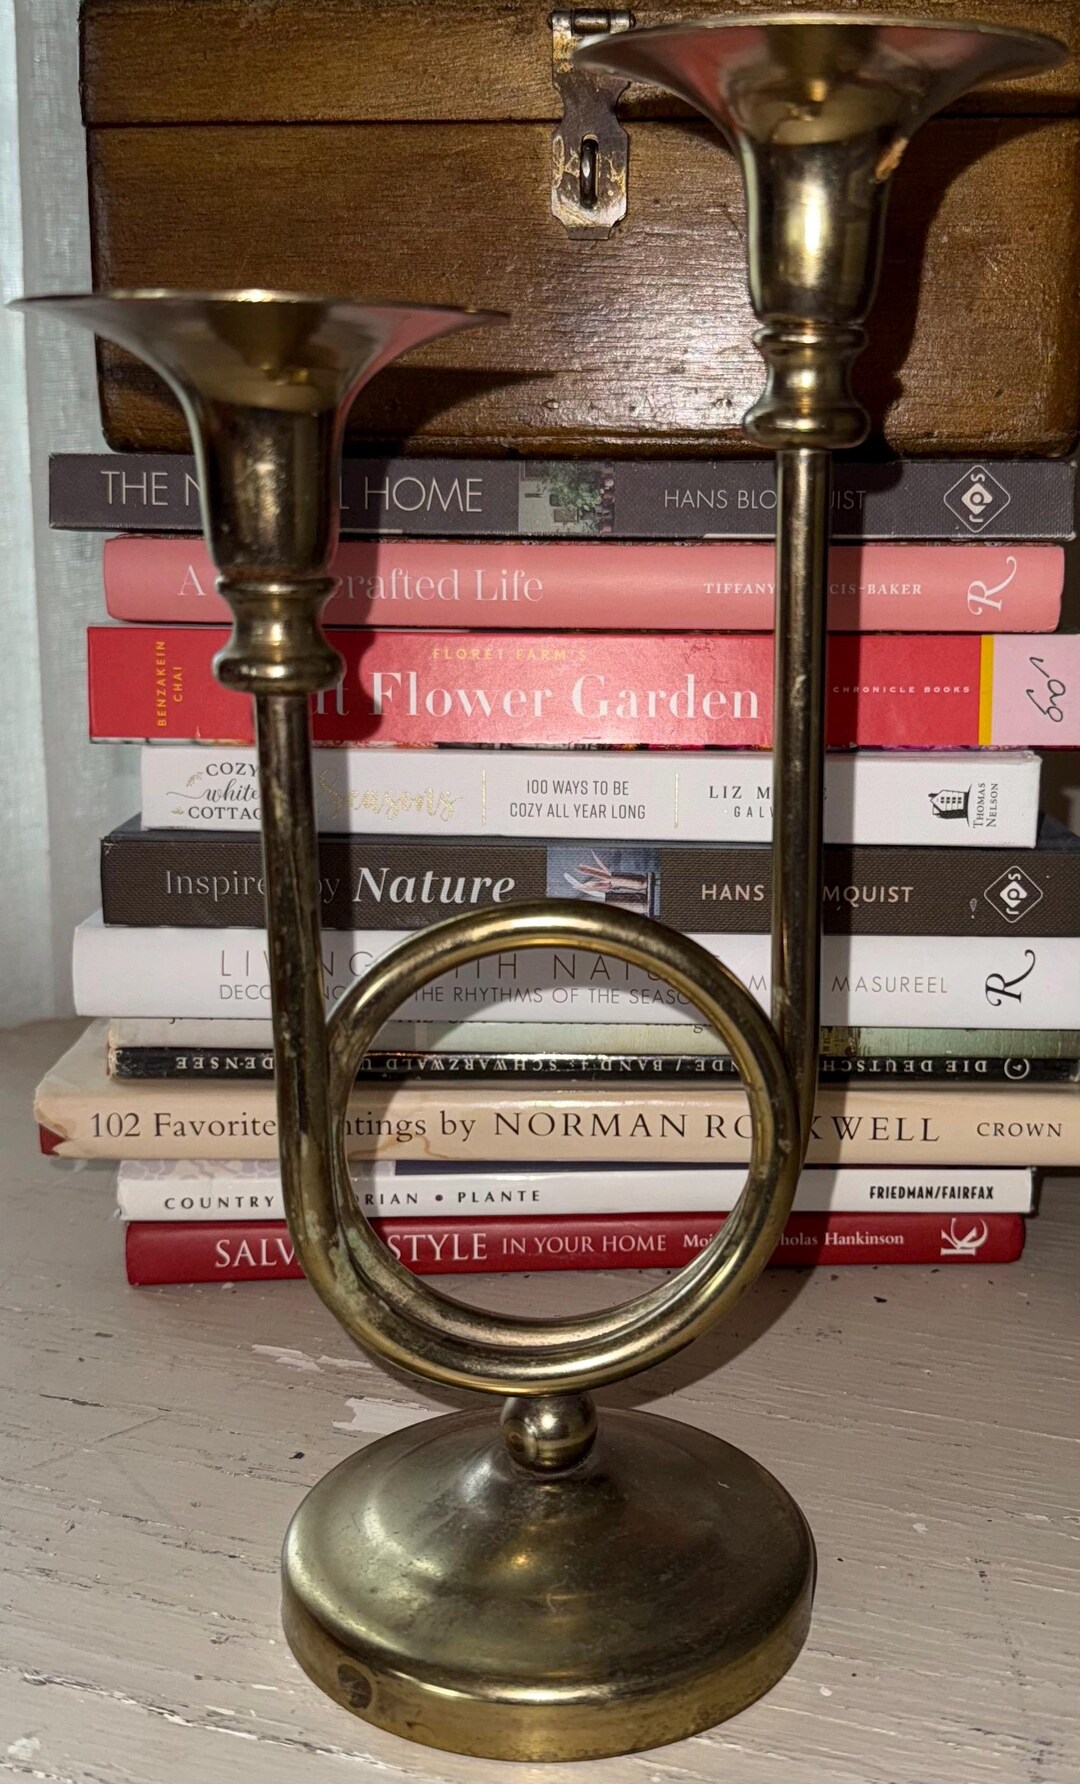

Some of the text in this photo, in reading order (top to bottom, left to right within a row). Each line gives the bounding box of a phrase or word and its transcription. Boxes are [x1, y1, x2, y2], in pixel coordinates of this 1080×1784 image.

[100, 470, 168, 506] THE
[364, 476, 483, 512] HOME
[664, 489, 728, 509] HANS
[177, 563, 206, 597] A
[472, 568, 544, 602] Life
[703, 583, 775, 595] TIFFANY
[967, 556, 1017, 615] R
[156, 641, 167, 727] BENZAKEIN
[173, 666, 183, 703] CHAI
[832, 686, 970, 694] CHRONICLE BOOKS
[368, 670, 553, 718] Flower
[571, 672, 762, 720] Garden
[205, 762, 259, 777] COZY
[526, 779, 630, 796] 100 WAYS TO BE
[709, 785, 743, 799] LIZ
[509, 802, 646, 820] COZY ALL YEAR LONG
[972, 782, 986, 829] THOMAS
[985, 782, 999, 828] NELSON
[352, 867, 516, 904] Nature
[701, 884, 765, 901] HANS
[831, 975, 948, 994] MASUREEL
[985, 949, 1036, 1007] R
[453, 986, 543, 1004] RHYTHMS
[552, 987, 579, 1004] OF
[588, 988, 620, 1004] THE
[385, 1057, 559, 1072] SCHWARZWALD
[601, 1058, 663, 1072] BAND
[945, 1059, 988, 1073] DIE
[91, 1112, 141, 1138] 102
[154, 1111, 277, 1137] Favorite
[440, 1110, 477, 1142] by
[494, 1112, 688, 1138] NORMAN
[976, 1121, 1063, 1138] CROWN
[164, 1189, 541, 1210] COUNTRY PLANTE
[869, 1185, 994, 1200] FRIEDMAN/FAIRFAX
[386, 1232, 488, 1263] STYLE
[502, 1237, 527, 1255] IN
[534, 1236, 595, 1254] YOUR
[602, 1234, 667, 1252] HOME
[824, 1230, 905, 1246] Hankinson
